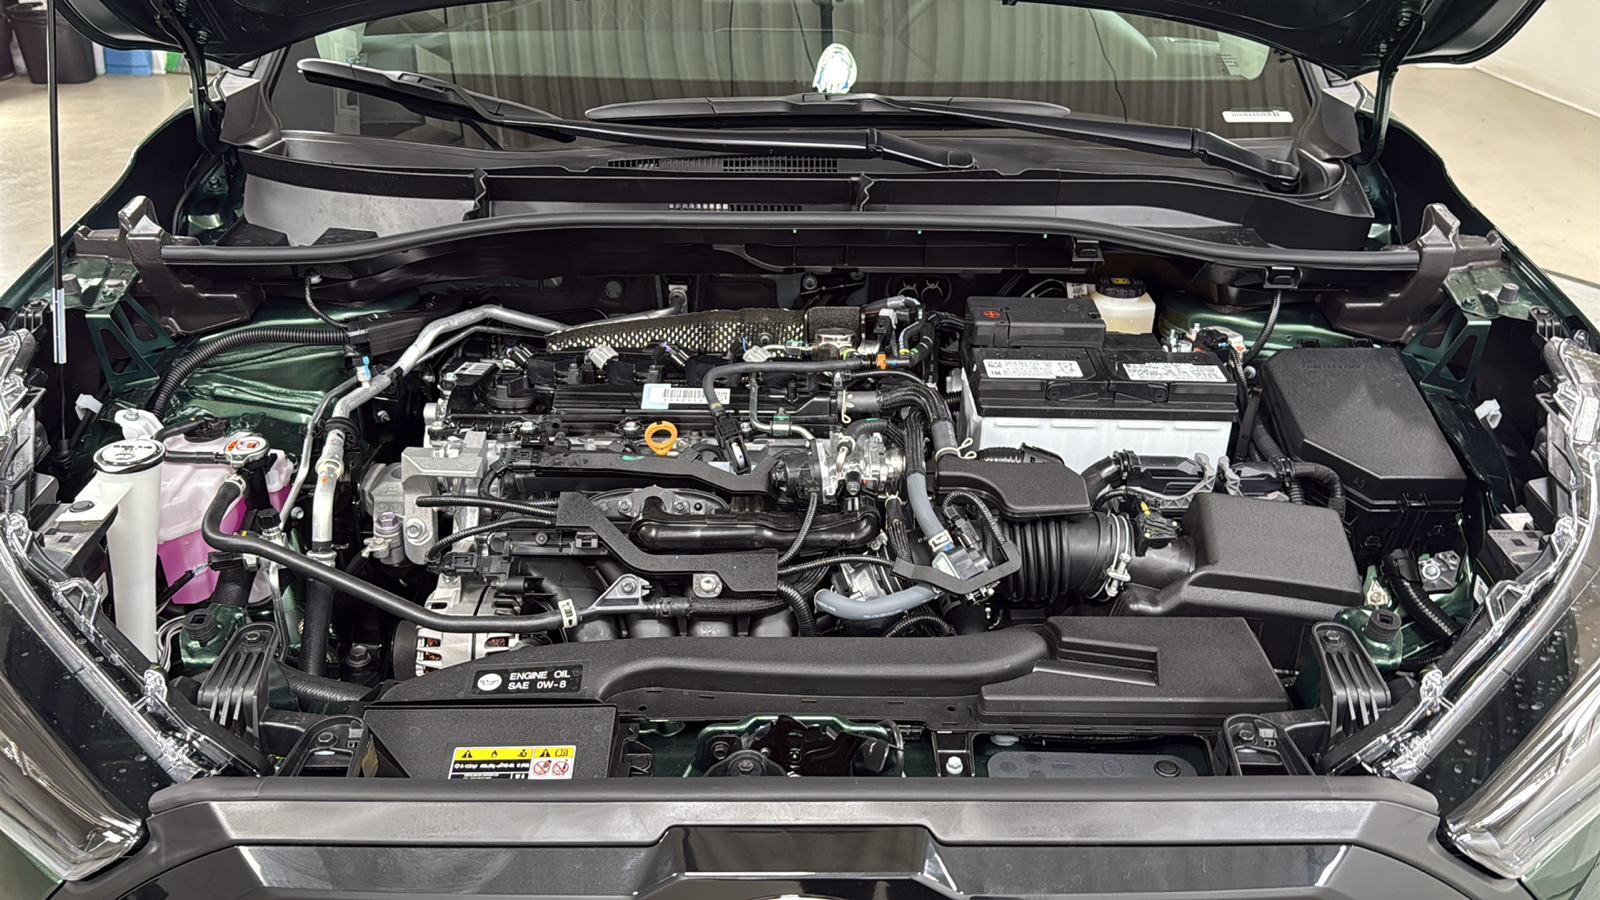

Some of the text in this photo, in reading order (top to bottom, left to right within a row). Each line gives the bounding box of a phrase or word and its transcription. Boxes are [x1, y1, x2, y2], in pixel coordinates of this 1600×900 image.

[509, 670, 571, 680] ENGINE OIL
[508, 680, 567, 690] SAE 0W-8
